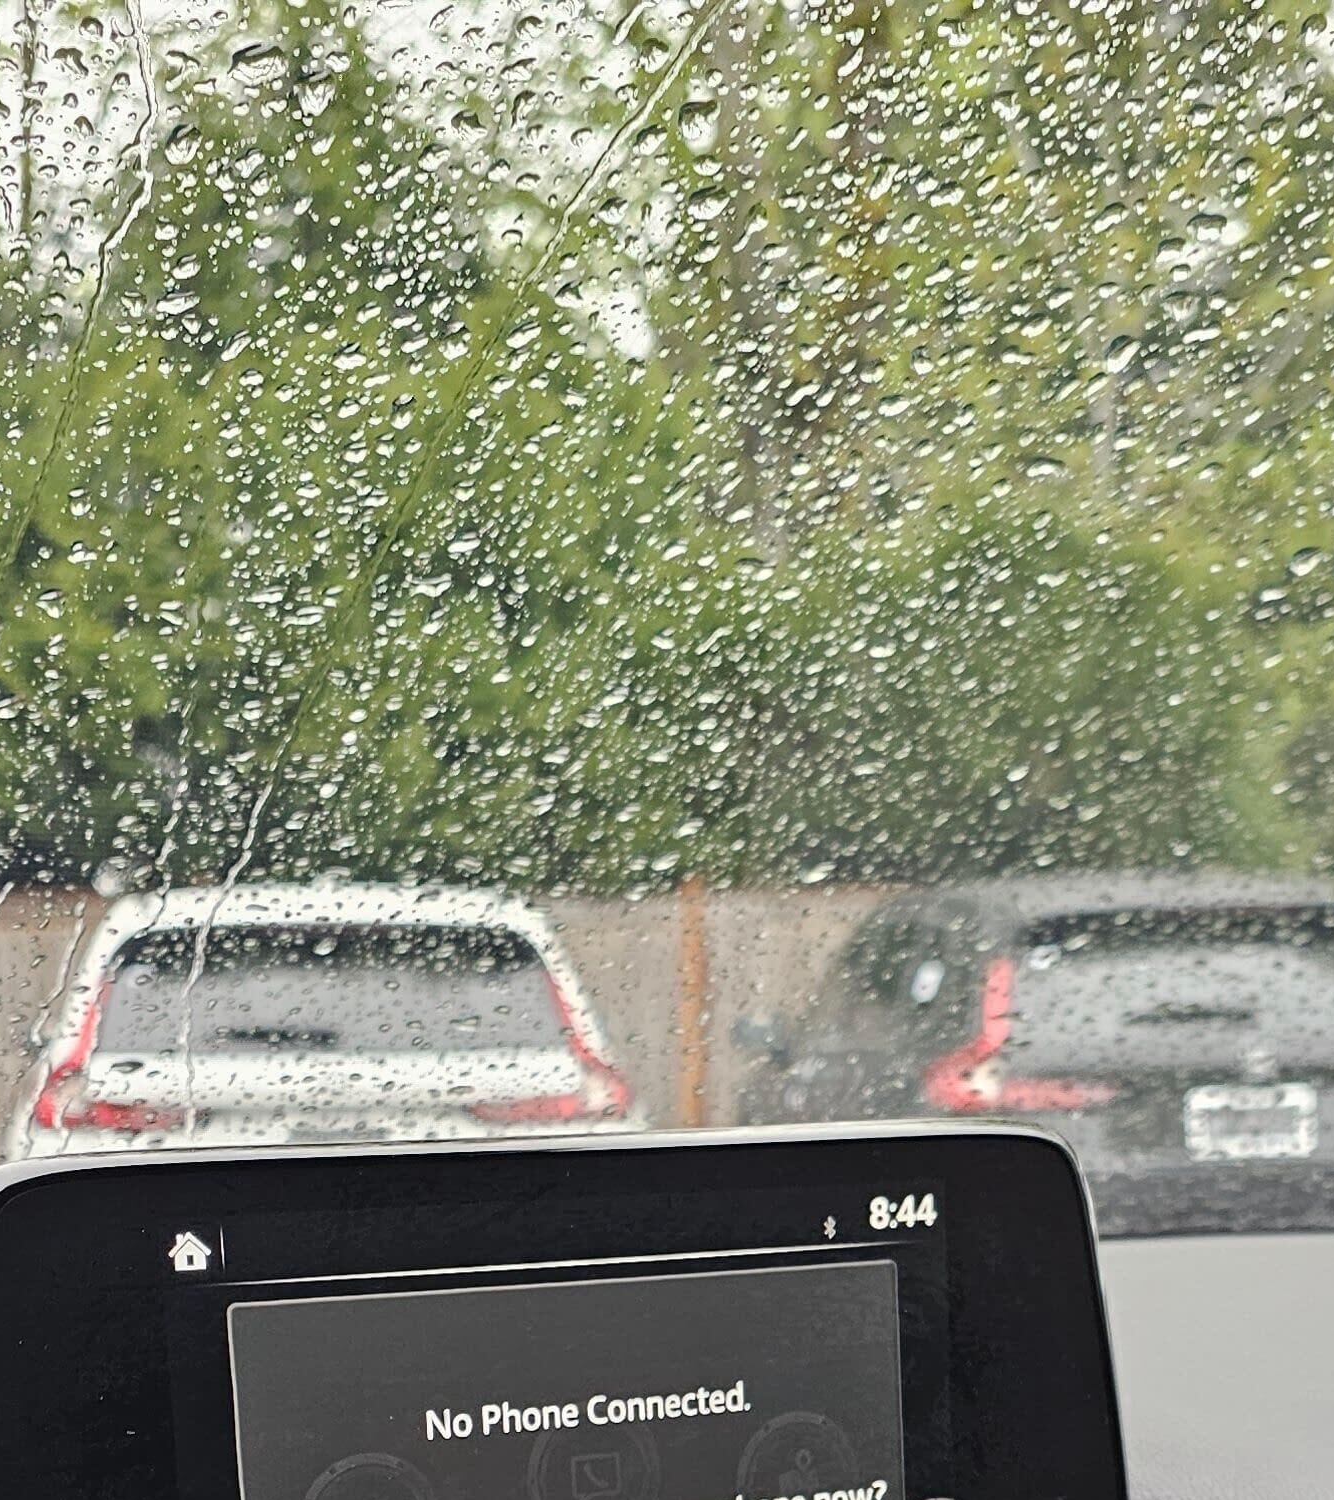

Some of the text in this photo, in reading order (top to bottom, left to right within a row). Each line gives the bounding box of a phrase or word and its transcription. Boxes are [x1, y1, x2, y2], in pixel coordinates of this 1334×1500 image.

[869, 1193, 938, 1231] 8:44
[424, 1379, 752, 1442] No Phone Connected.
